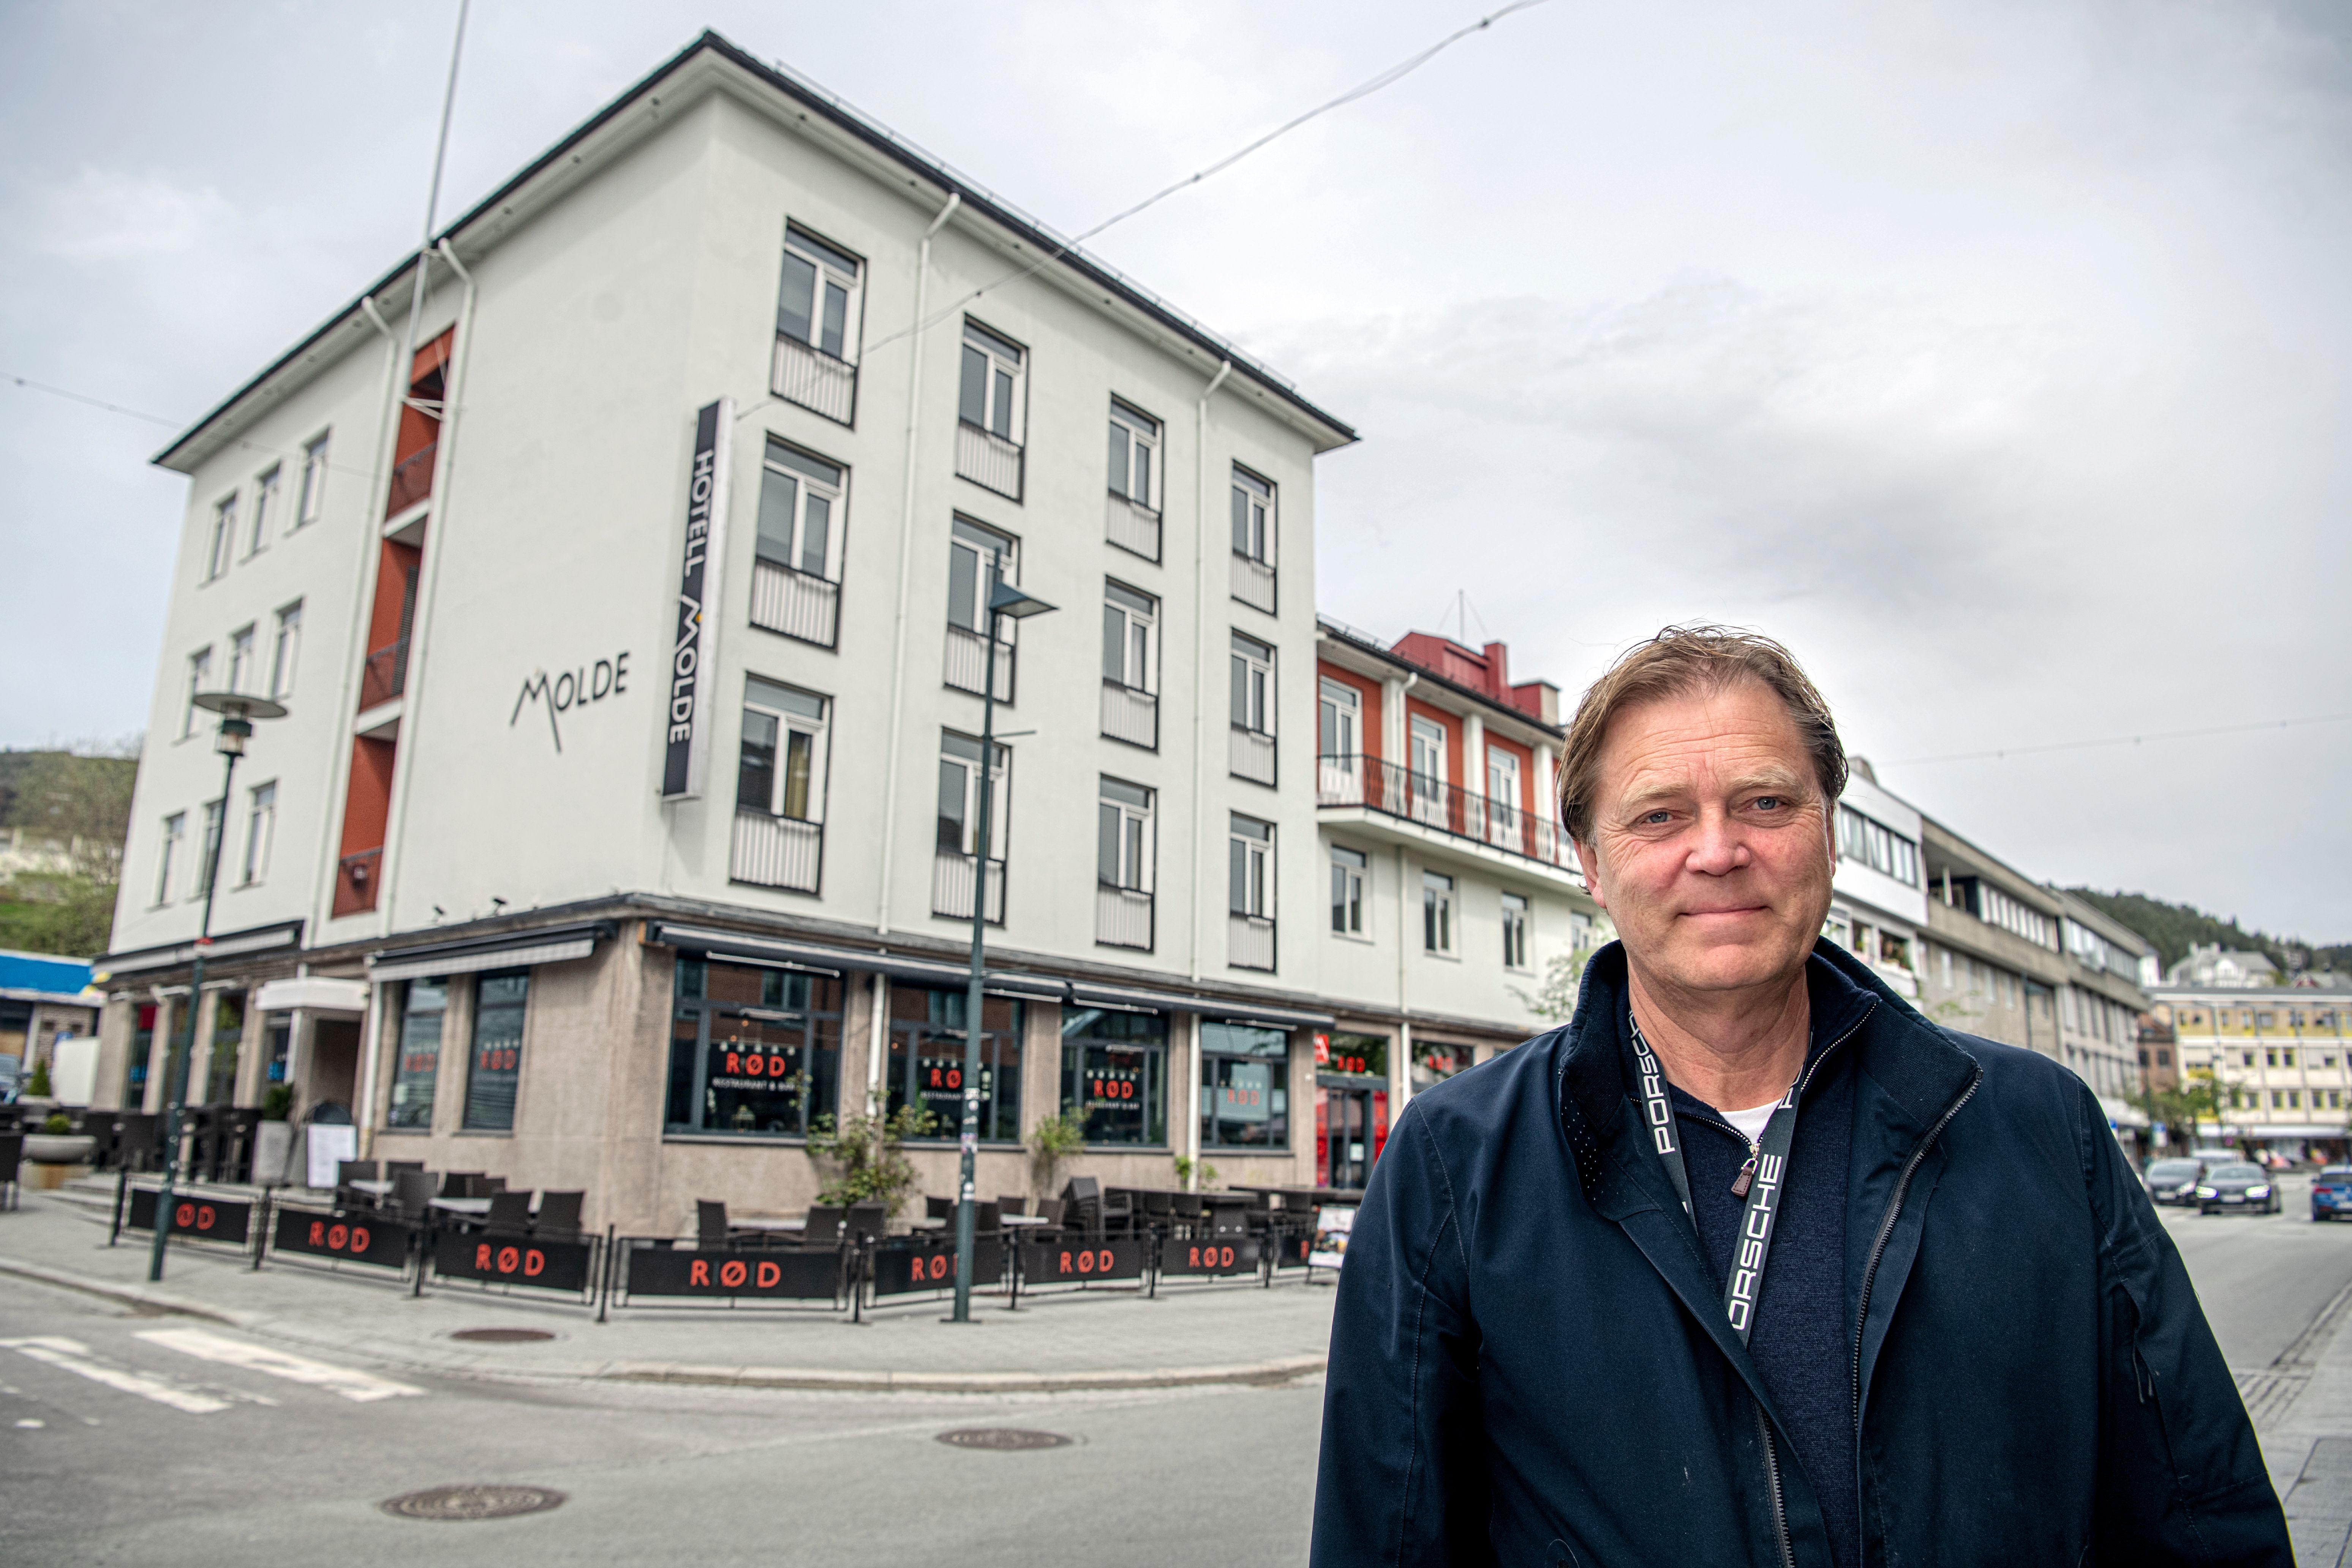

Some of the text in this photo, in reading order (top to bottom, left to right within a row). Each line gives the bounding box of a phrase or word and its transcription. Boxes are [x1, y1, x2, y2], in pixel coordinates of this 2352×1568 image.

[669, 449, 714, 744] HOTELL MOLDE
[510, 650, 630, 754] MOLDE
[1628, 1008, 1675, 1154] PORSCH
[176, 1203, 215, 1230] ØD
[475, 1243, 545, 1276] RØD
[1728, 1154, 1782, 1330] ORSCHE
[690, 1259, 781, 1288] RØD
